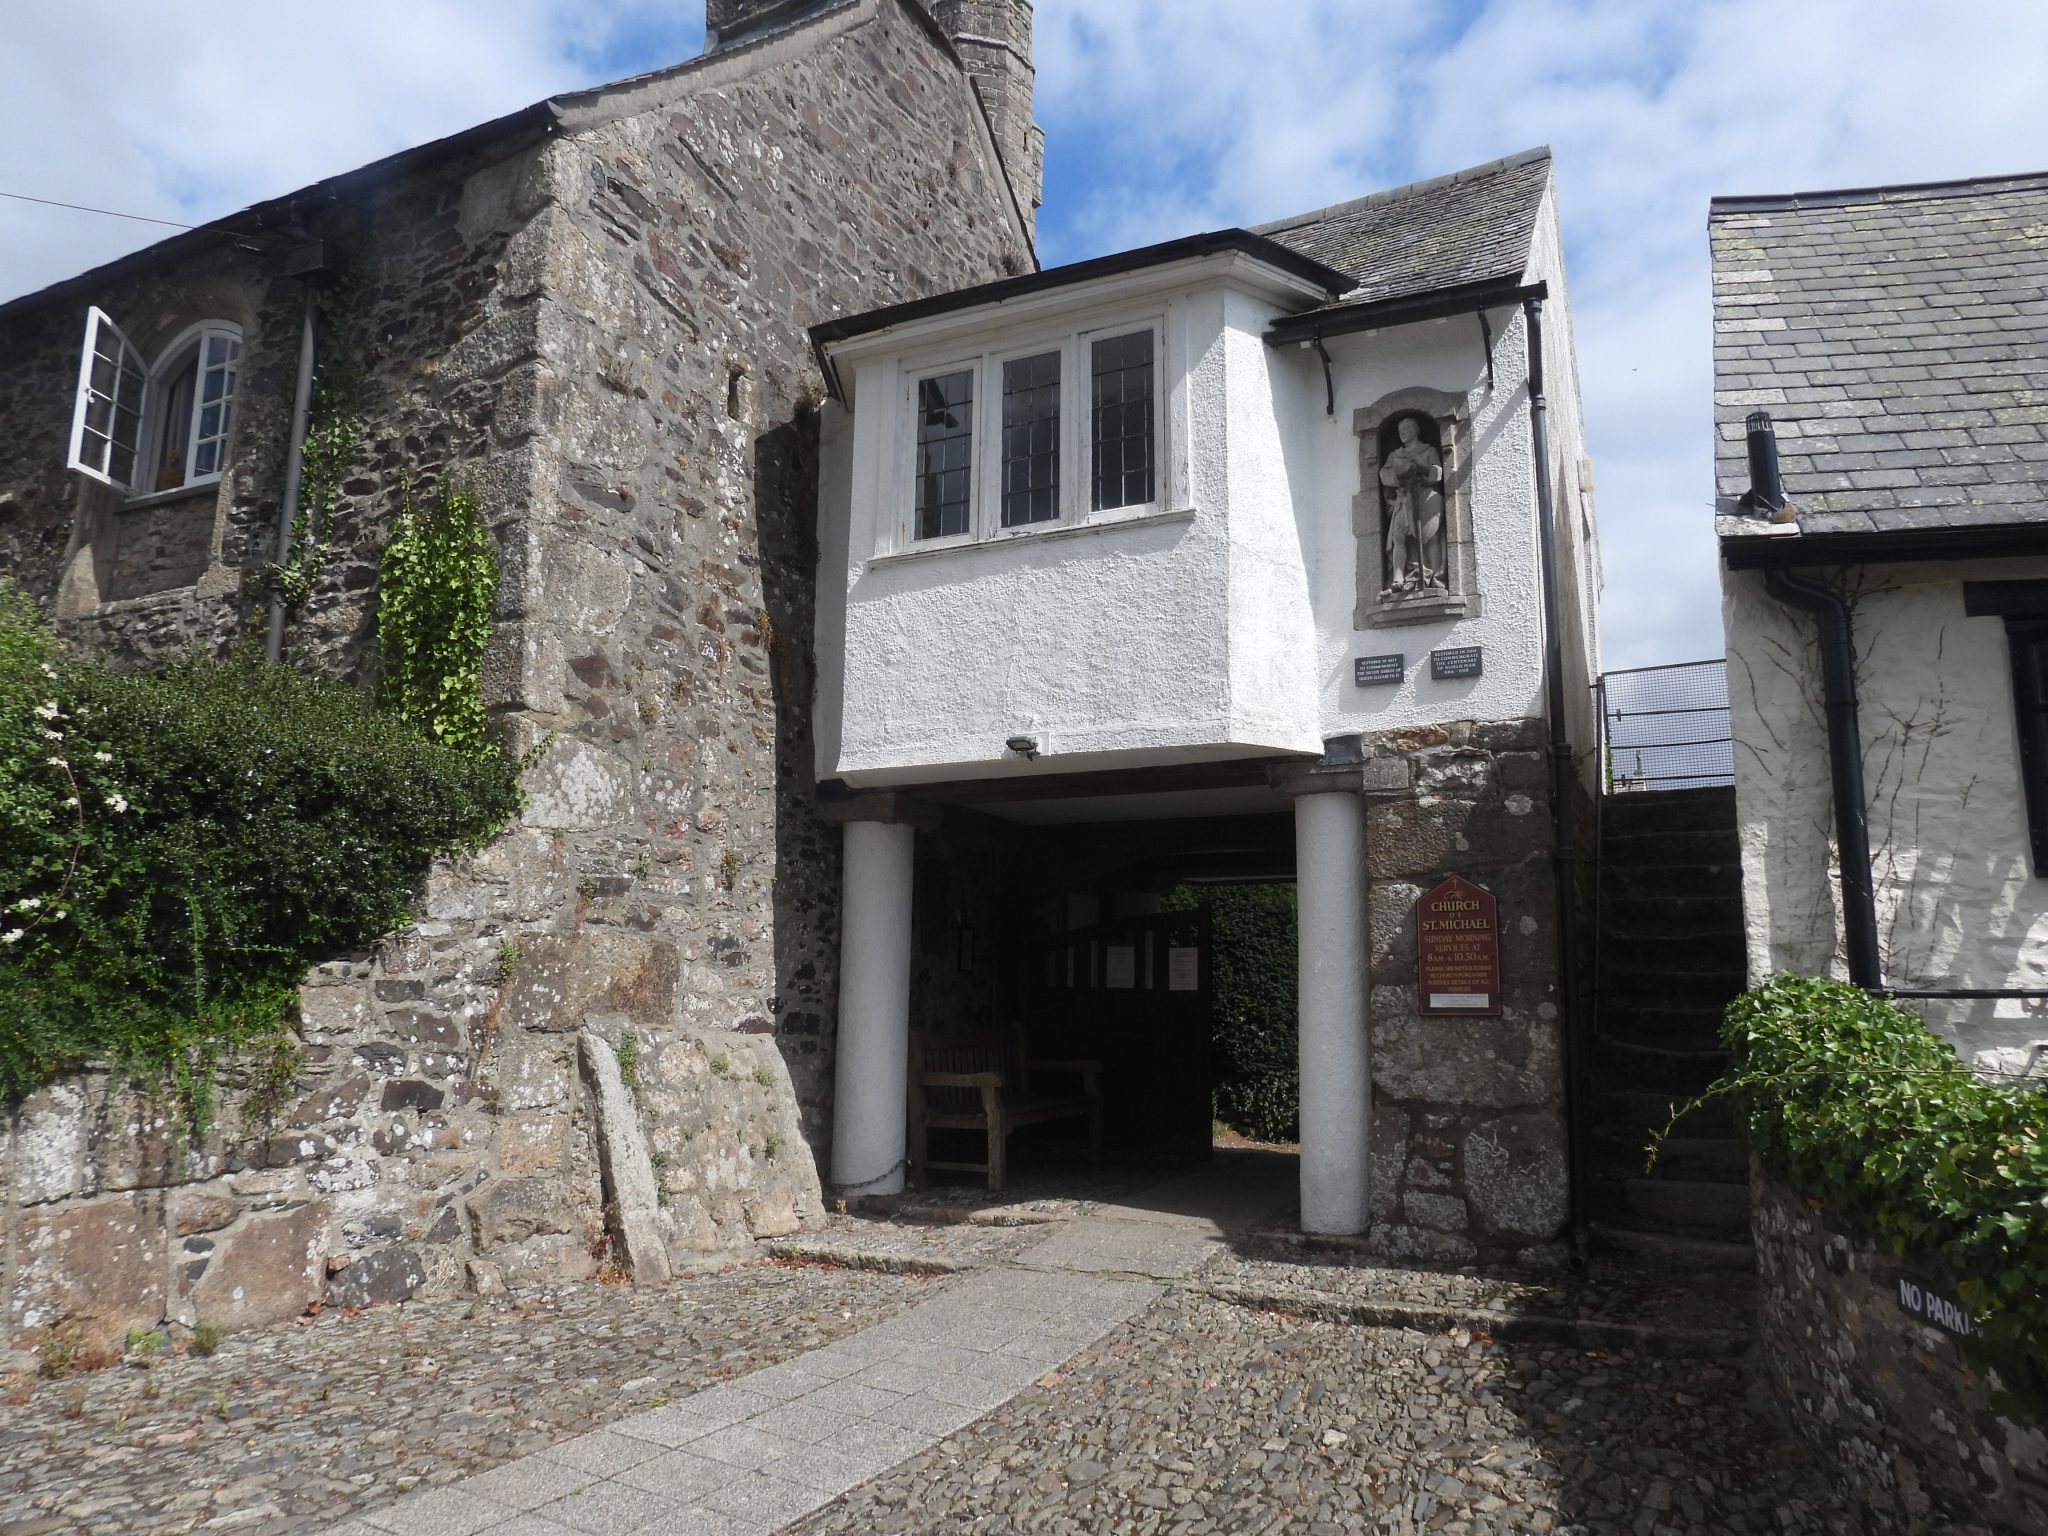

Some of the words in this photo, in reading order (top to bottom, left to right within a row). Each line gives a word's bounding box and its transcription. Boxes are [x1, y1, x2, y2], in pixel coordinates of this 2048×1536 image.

[1431, 900, 1480, 912] CHURCH
[1428, 953, 1433, 961] 8
[1455, 952, 1476, 960] 10.30
[1900, 1280, 1921, 1311] NO
